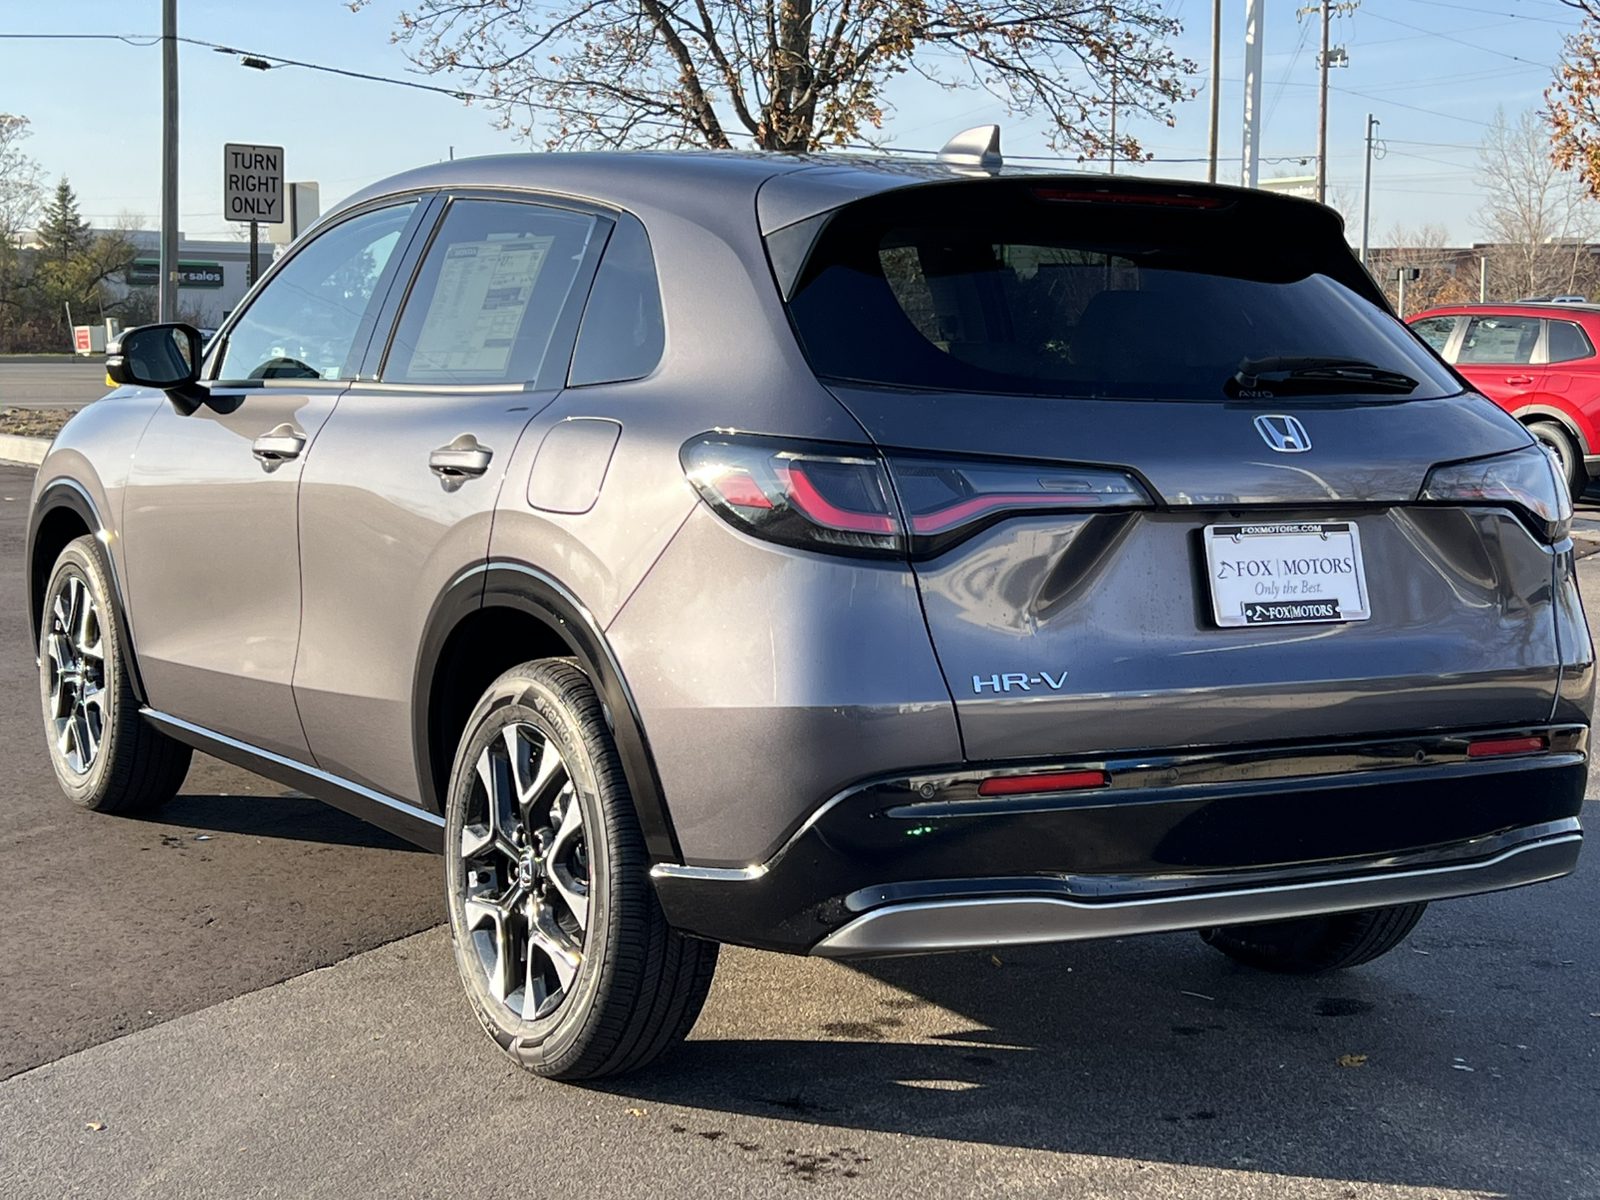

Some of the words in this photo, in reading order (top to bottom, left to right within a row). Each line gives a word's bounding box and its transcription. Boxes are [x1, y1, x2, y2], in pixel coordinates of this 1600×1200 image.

[231, 151, 277, 171] TURN
[229, 174, 279, 193] RIGHT
[231, 196, 276, 215] ONLY
[189, 270, 220, 281] sales
[1238, 390, 1274, 398] AWD
[1241, 525, 1322, 535] FOXMOTORS.COM
[1236, 560, 1273, 577] FOX
[1283, 557, 1352, 576] MOTORS
[1254, 580, 1280, 599] Only
[1282, 580, 1298, 594] the
[1300, 580, 1323, 594] Best.
[972, 671, 1068, 693] HR-V
